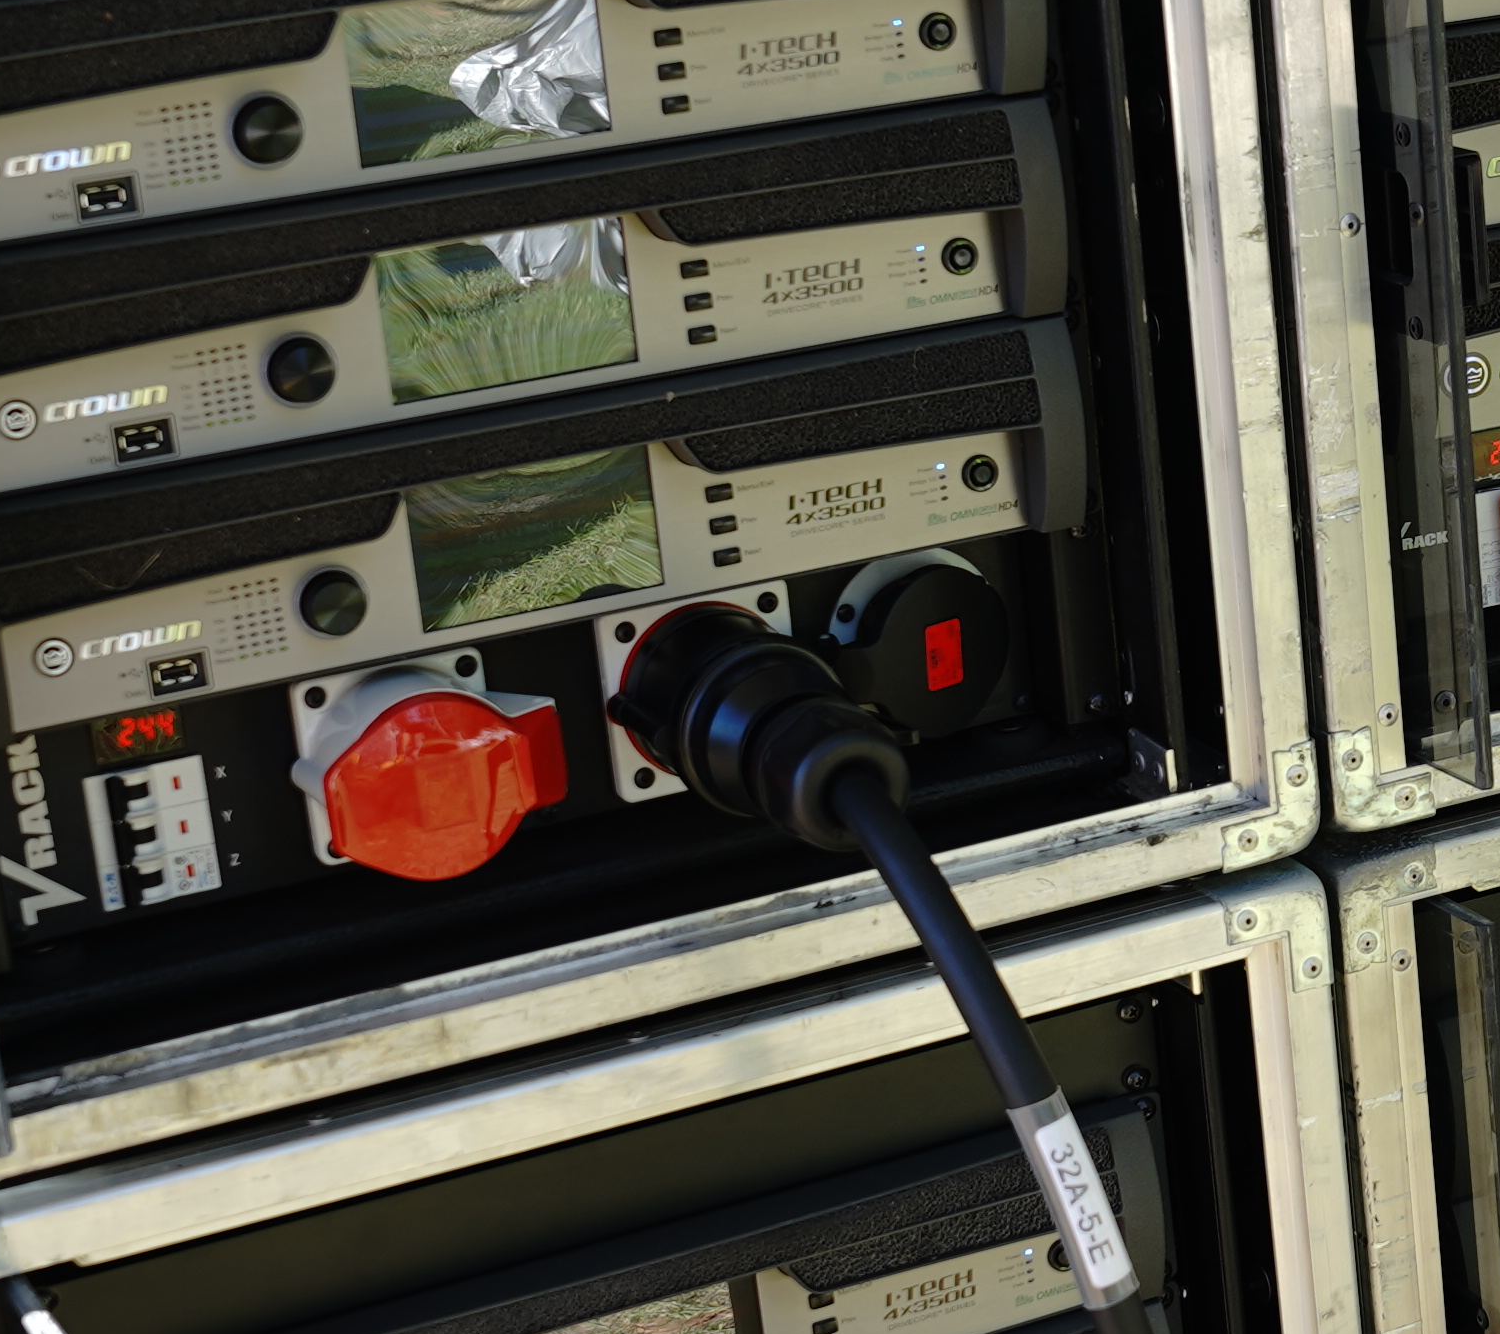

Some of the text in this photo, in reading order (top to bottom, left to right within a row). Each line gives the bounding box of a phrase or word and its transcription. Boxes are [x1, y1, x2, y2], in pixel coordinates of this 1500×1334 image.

[3, 139, 132, 178] crown
[43, 384, 168, 424] crown
[79, 619, 202, 660] crown
[117, 712, 175, 748] 244
[214, 766, 227, 779] X
[221, 809, 233, 822] Y
[229, 852, 242, 867] Z
[1050, 1142, 1115, 1266] 32A-5-E
